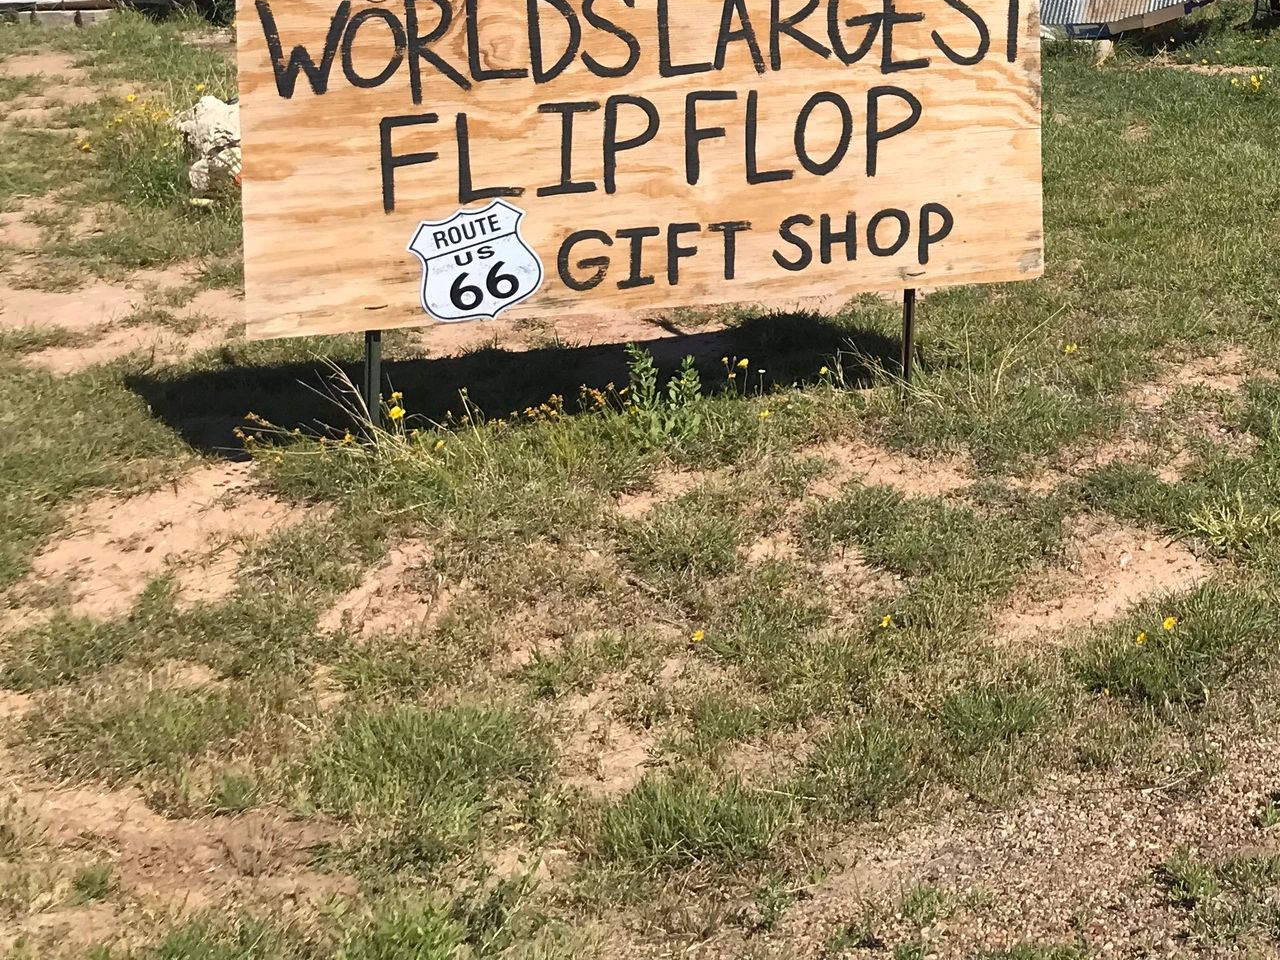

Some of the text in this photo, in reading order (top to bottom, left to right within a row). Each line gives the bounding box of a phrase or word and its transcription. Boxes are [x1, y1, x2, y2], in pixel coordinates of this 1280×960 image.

[379, 85, 923, 214] FLIP FLOP
[432, 212, 503, 250] ROUTE
[454, 245, 495, 266] US
[556, 201, 955, 292] GIFT SHOP
[449, 261, 520, 312] 66
